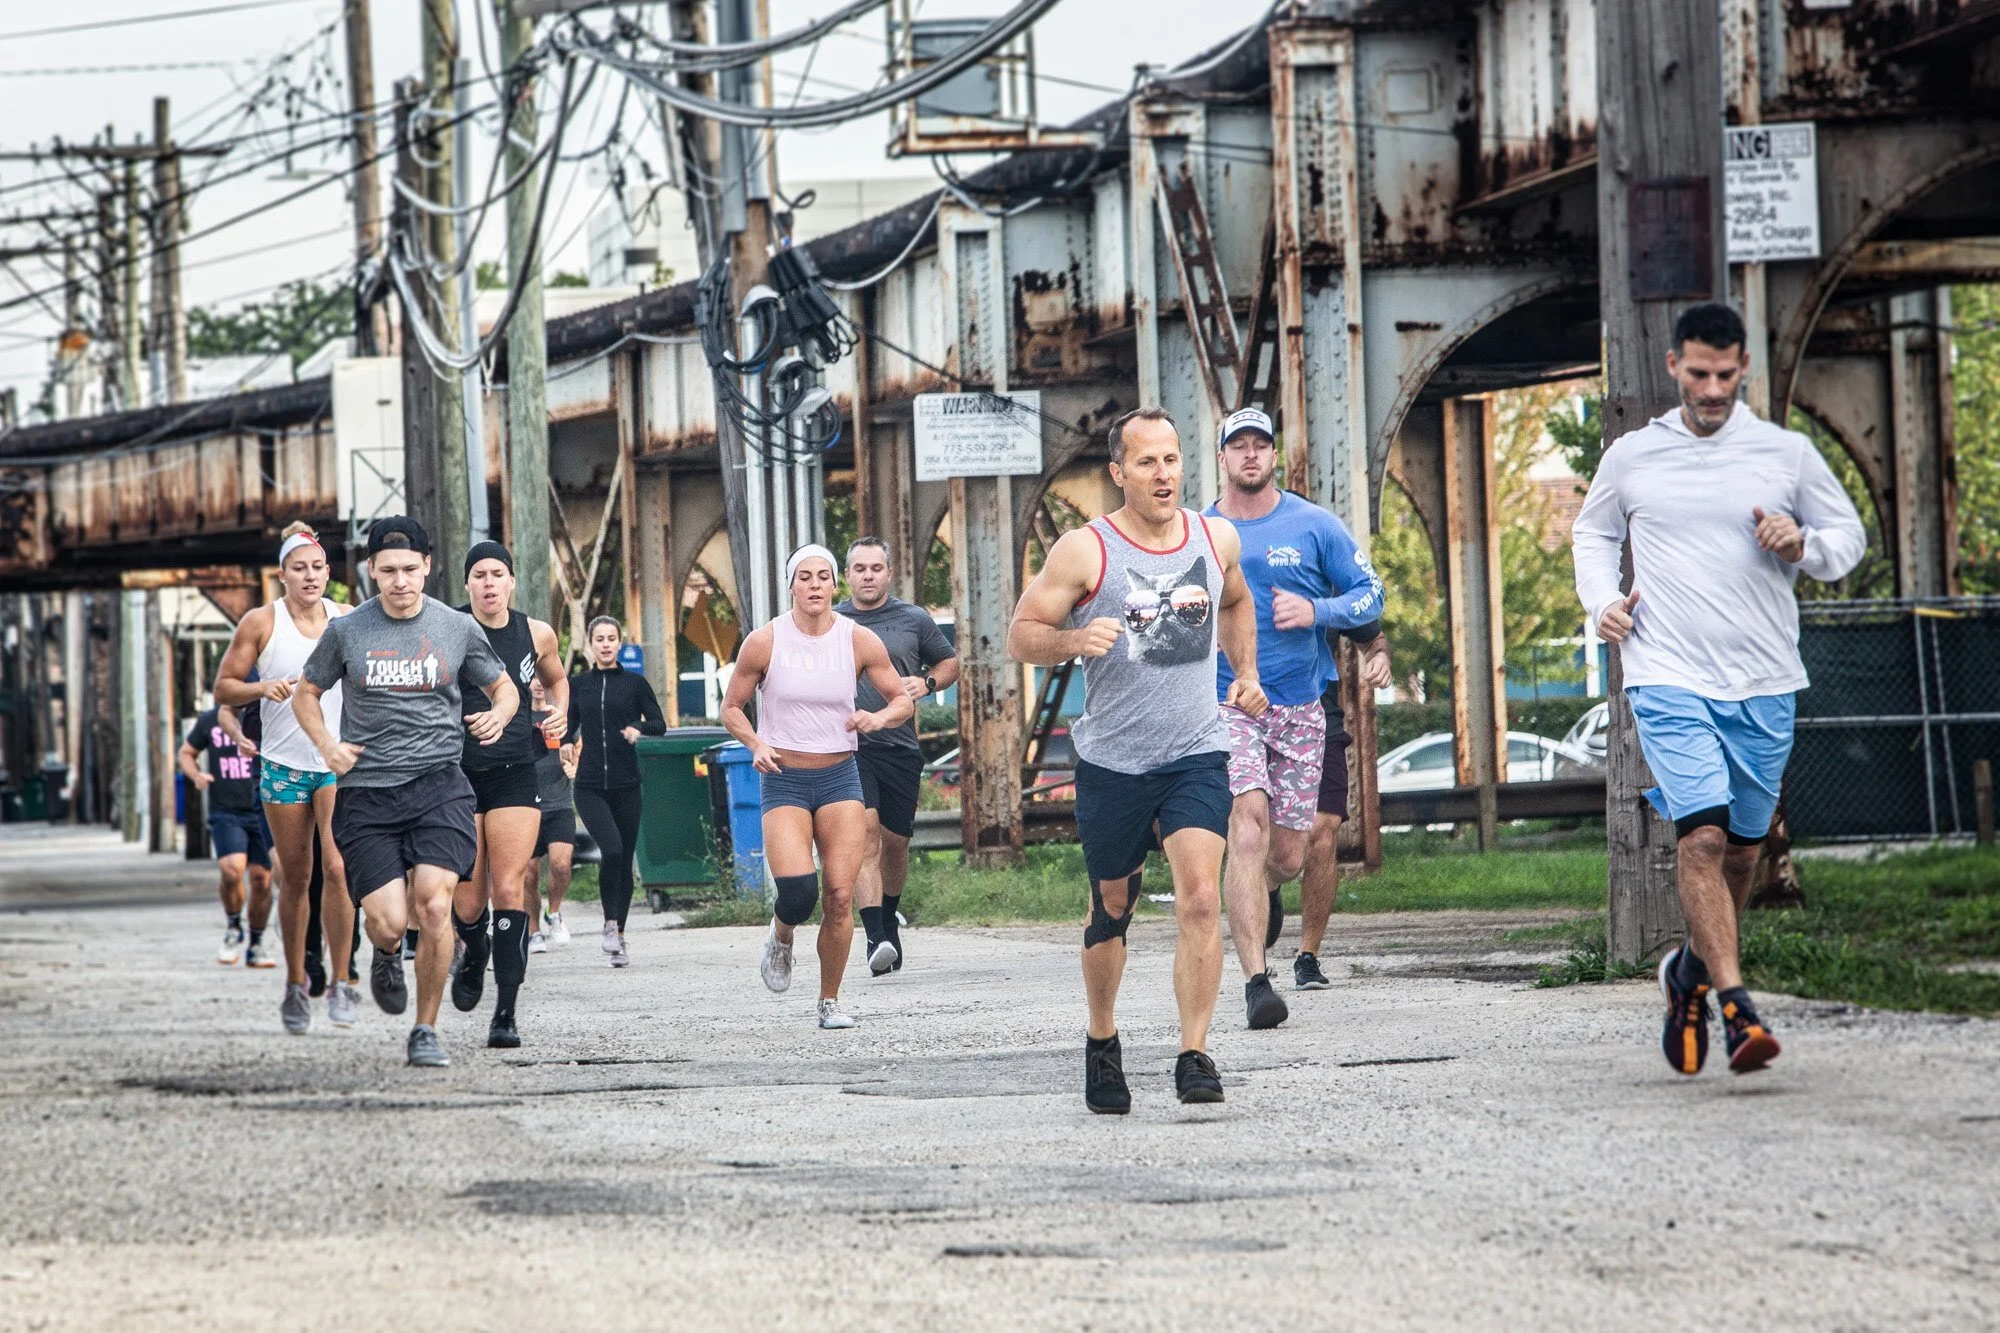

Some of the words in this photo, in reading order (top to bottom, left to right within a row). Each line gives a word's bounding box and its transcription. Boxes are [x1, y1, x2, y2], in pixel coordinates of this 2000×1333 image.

[1761, 225, 1812, 241] Chicago
[366, 659, 423, 676] TOUGH
[366, 674, 424, 687] MUDDER
